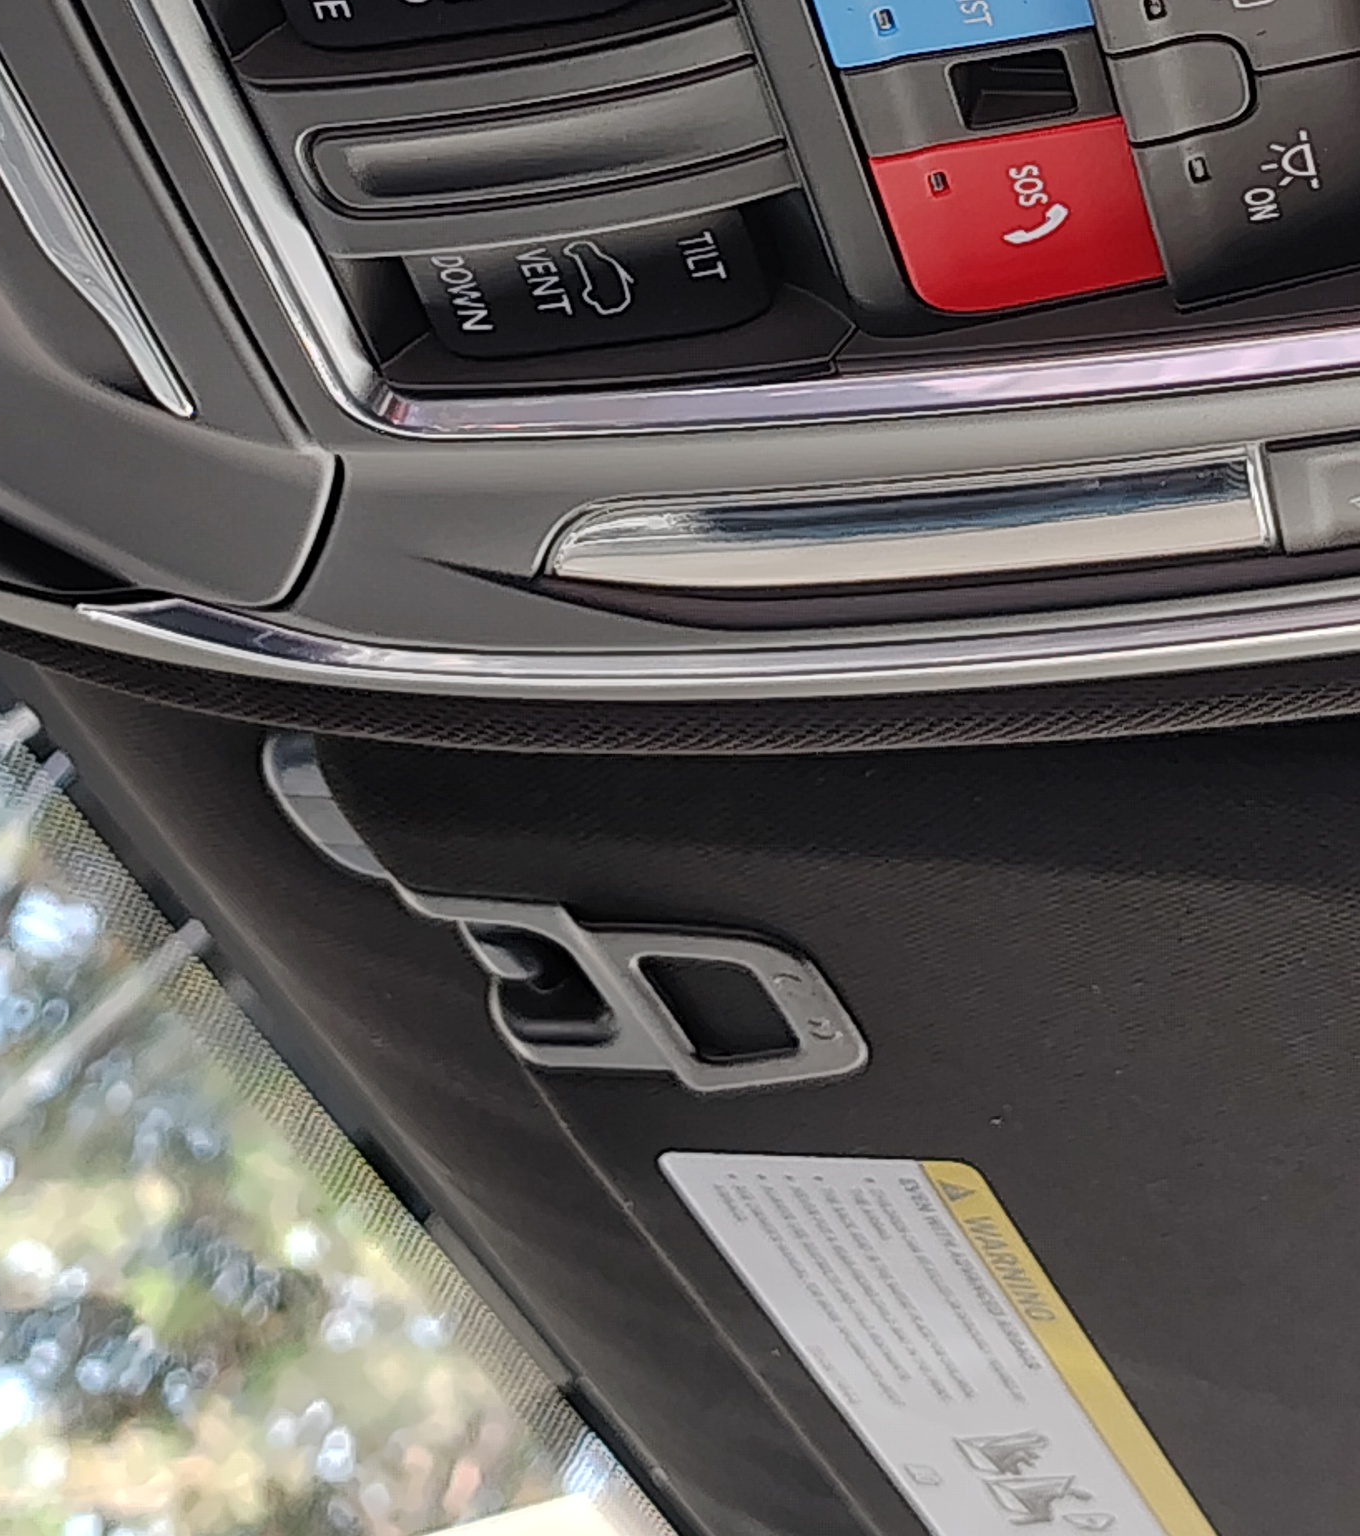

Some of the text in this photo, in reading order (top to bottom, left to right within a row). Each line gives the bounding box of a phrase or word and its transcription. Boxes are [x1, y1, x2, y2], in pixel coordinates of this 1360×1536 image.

[1007, 164, 1049, 208] SOS
[1242, 186, 1281, 223] ON
[515, 247, 574, 316] VENT
[677, 230, 727, 281] TILT
[430, 255, 495, 332] DOWN
[963, 1216, 1056, 1322] WARNING
